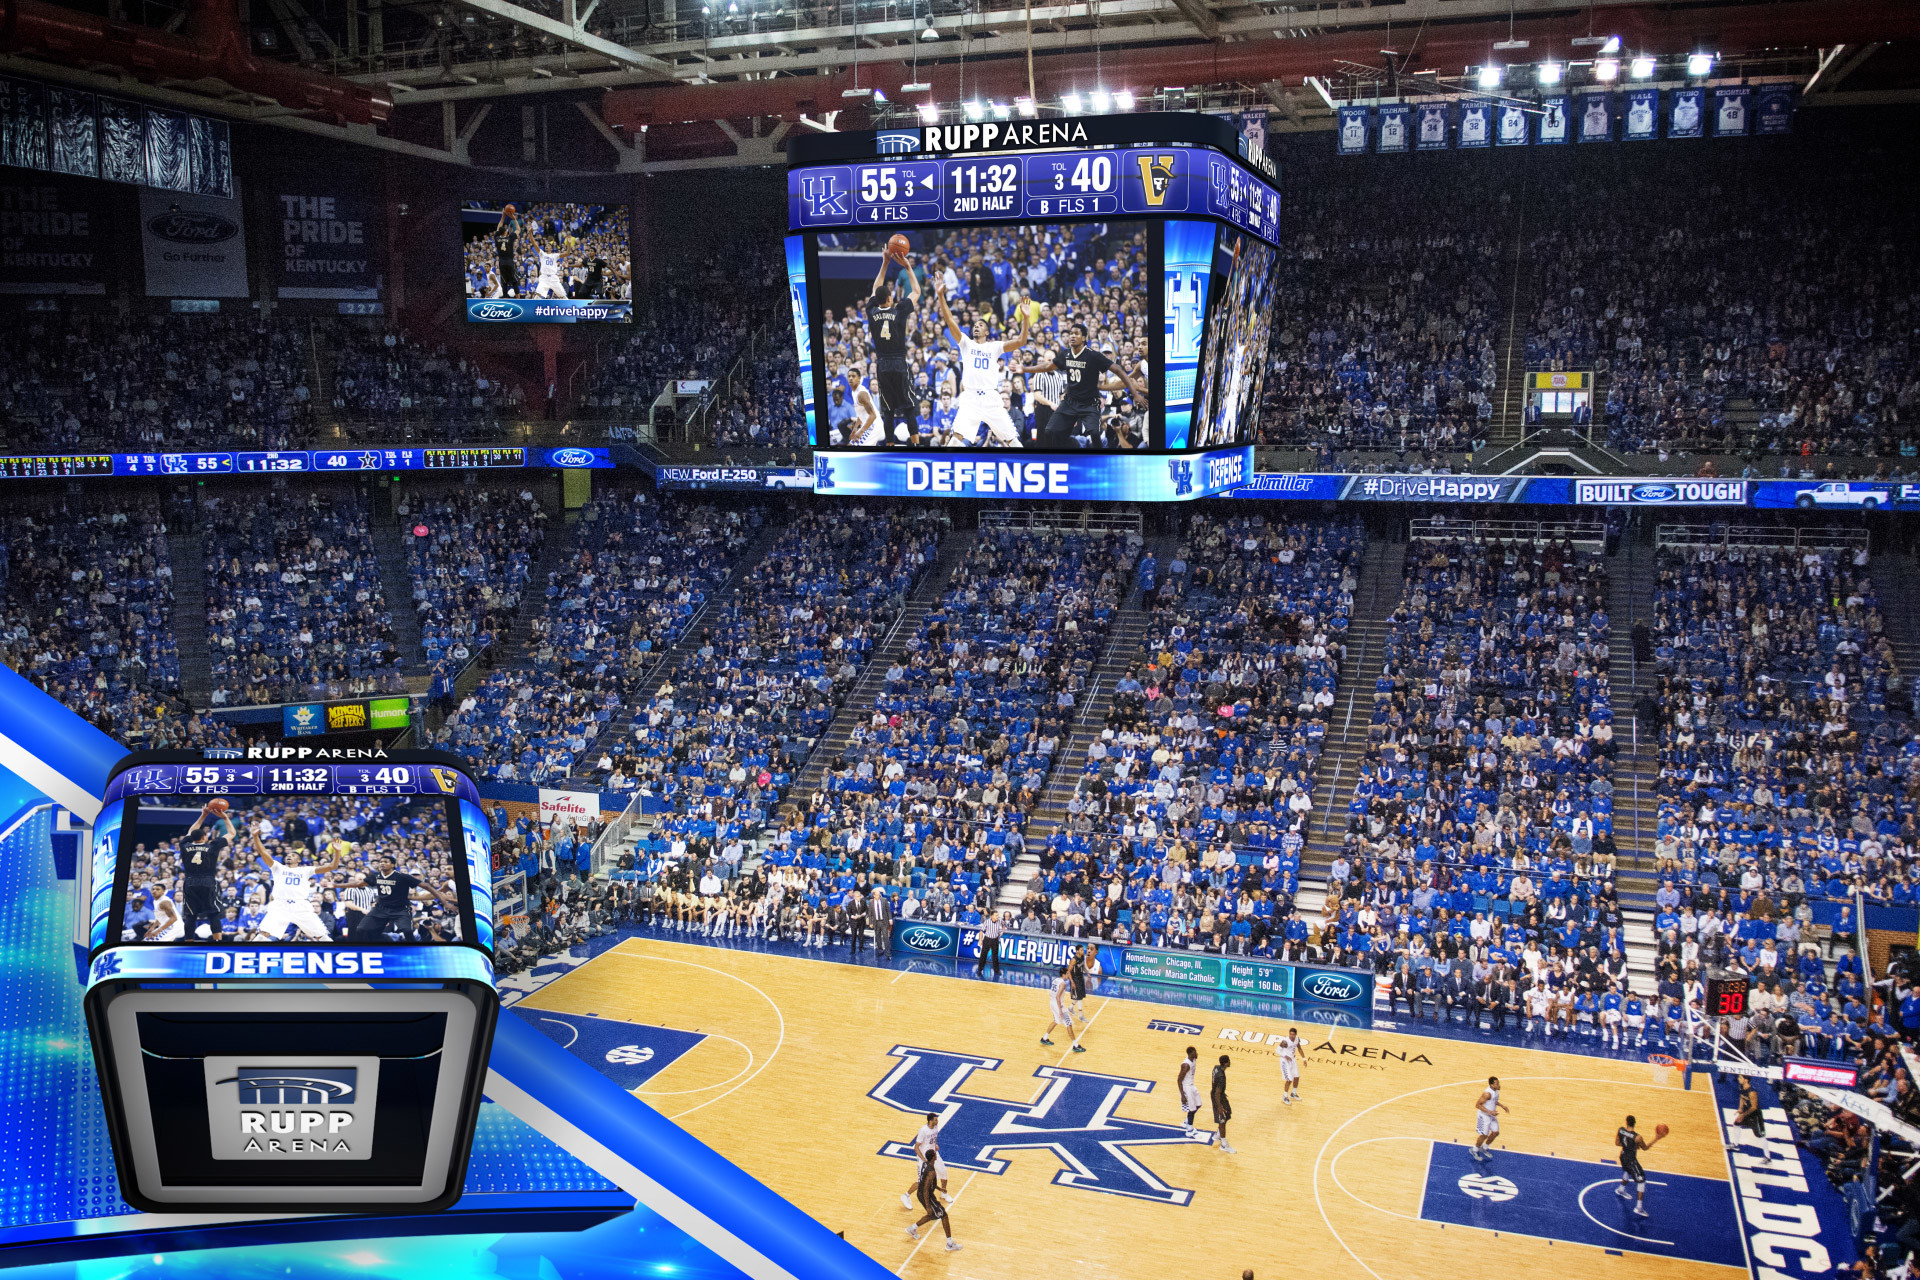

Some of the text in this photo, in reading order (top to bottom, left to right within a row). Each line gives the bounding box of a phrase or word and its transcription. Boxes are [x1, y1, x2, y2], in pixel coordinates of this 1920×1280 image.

[1715, 88, 1750, 96] KEIGHTLEY
[1508, 119, 1518, 127] 24
[926, 122, 1088, 152] RUPP ARENA
[1248, 131, 1258, 140] 34
[1350, 130, 1357, 138] 11
[1388, 128, 1398, 136] 12
[1052, 162, 1066, 171] TOL
[1248, 139, 1277, 180] RUPP ARENA
[951, 164, 1016, 194] 11:32
[1071, 156, 1111, 192] 40
[861, 167, 898, 202] 55
[904, 182, 914, 197] 3
[1054, 175, 1064, 190] 3
[1230, 166, 1240, 202] 55
[0, 186, 58, 210] THE
[954, 196, 1013, 212] 2ND HALF
[1040, 198, 1099, 214] B FLS 1
[281, 195, 336, 219] THE
[870, 207, 908, 221] 4 FLS
[1, 212, 90, 236] PRIDE
[166, 216, 221, 239] Ford
[283, 220, 364, 244] PRIDE
[3, 237, 24, 250] OF
[284, 244, 306, 257] OF
[3, 252, 94, 267] KENTUCKY
[163, 252, 226, 263] Go Further
[285, 260, 368, 273] KENTUCKY
[347, 303, 376, 314] 227
[480, 304, 608, 319] Ford #drivehappy
[880, 320, 891, 340] 4
[974, 358, 989, 370] 00
[1069, 369, 1081, 383] 30
[163, 454, 187, 473] UK
[197, 458, 218, 470] 55
[247, 459, 302, 470] 11:32
[327, 455, 347, 467] 40
[561, 451, 586, 464] Ford
[663, 469, 756, 480] NEW Ford F-250
[907, 461, 1069, 494] DEFENSE
[1209, 455, 1242, 489] DEFENSE
[1263, 475, 1313, 491] miller
[1364, 479, 1500, 500] #DriveHappy
[1582, 483, 1741, 502] BUILT Ford TOUGH
[328, 704, 366, 722] MINGUA
[330, 715, 366, 728] BEEF JERKY
[541, 801, 586, 814] Safelite
[910, 928, 940, 948] Ford
[999, 937, 1038, 962] YLER
[1125, 952, 1158, 964] Hometown
[1166, 957, 1195, 969] Chicago,
[1125, 965, 1215, 984] High School Marian Catholic
[1232, 965, 1252, 976] Height
[1231, 977, 1282, 992] Weight 160 lbs
[1313, 976, 1350, 998] Ford
[1718, 993, 1743, 1014] 30
[1314, 1041, 1433, 1066] ARENA
[1307, 1057, 1388, 1071] KENTUCKY
[866, 1044, 1217, 1206] UK
